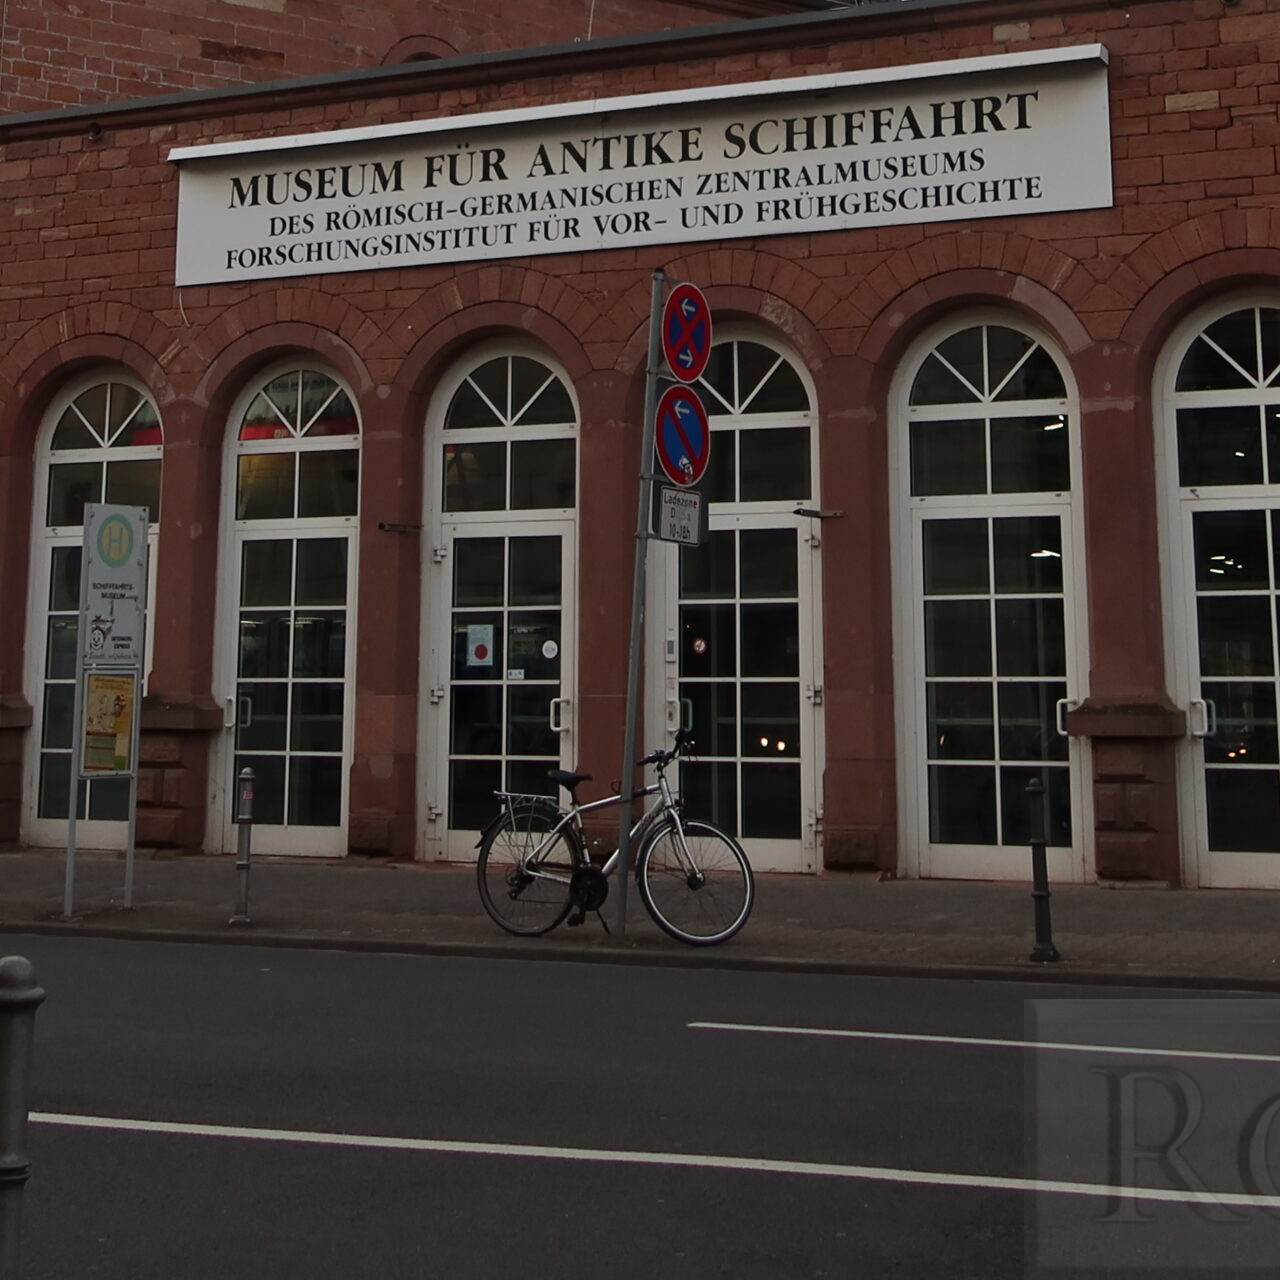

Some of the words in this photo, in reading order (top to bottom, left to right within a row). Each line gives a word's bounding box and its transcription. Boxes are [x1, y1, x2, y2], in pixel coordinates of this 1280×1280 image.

[228, 159, 405, 209] MUSEUM
[424, 144, 508, 188] FÜR
[526, 127, 703, 178] ANTIKE
[723, 91, 1039, 160] SCHIFFAHRT
[269, 214, 314, 237] DES
[325, 175, 684, 232] RÖMISCH-GERMANISCHEN
[696, 148, 985, 196] ZENTRALMUSEUMS
[225, 223, 518, 270] FORSCHUNGSINSTITUT
[528, 214, 581, 243] FÜR
[593, 209, 667, 237] VOR-
[680, 202, 744, 229] UND
[756, 176, 1043, 222] FRÜHGESCHICHTE
